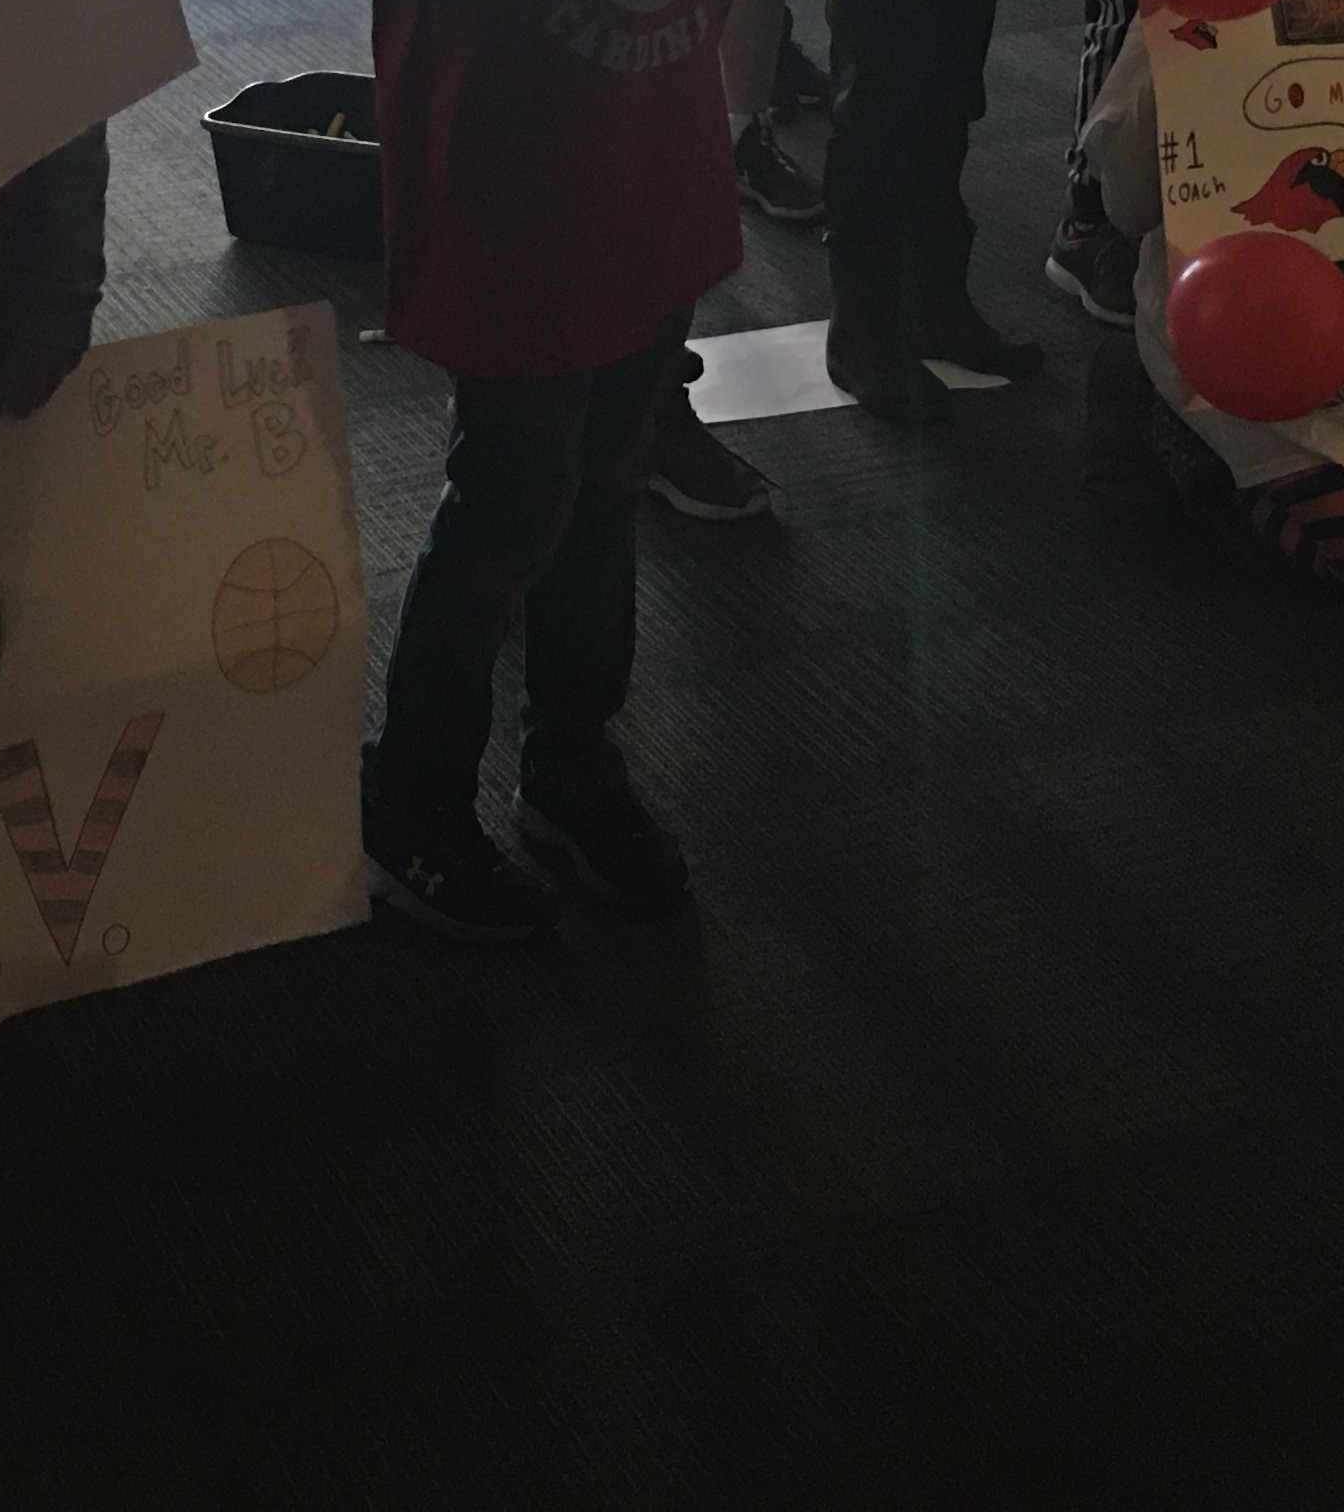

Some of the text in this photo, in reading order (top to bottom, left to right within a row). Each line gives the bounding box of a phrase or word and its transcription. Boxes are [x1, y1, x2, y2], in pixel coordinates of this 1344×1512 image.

[1160, 131, 1204, 176] #1
[90, 337, 192, 438] Good
[250, 400, 309, 478] B
